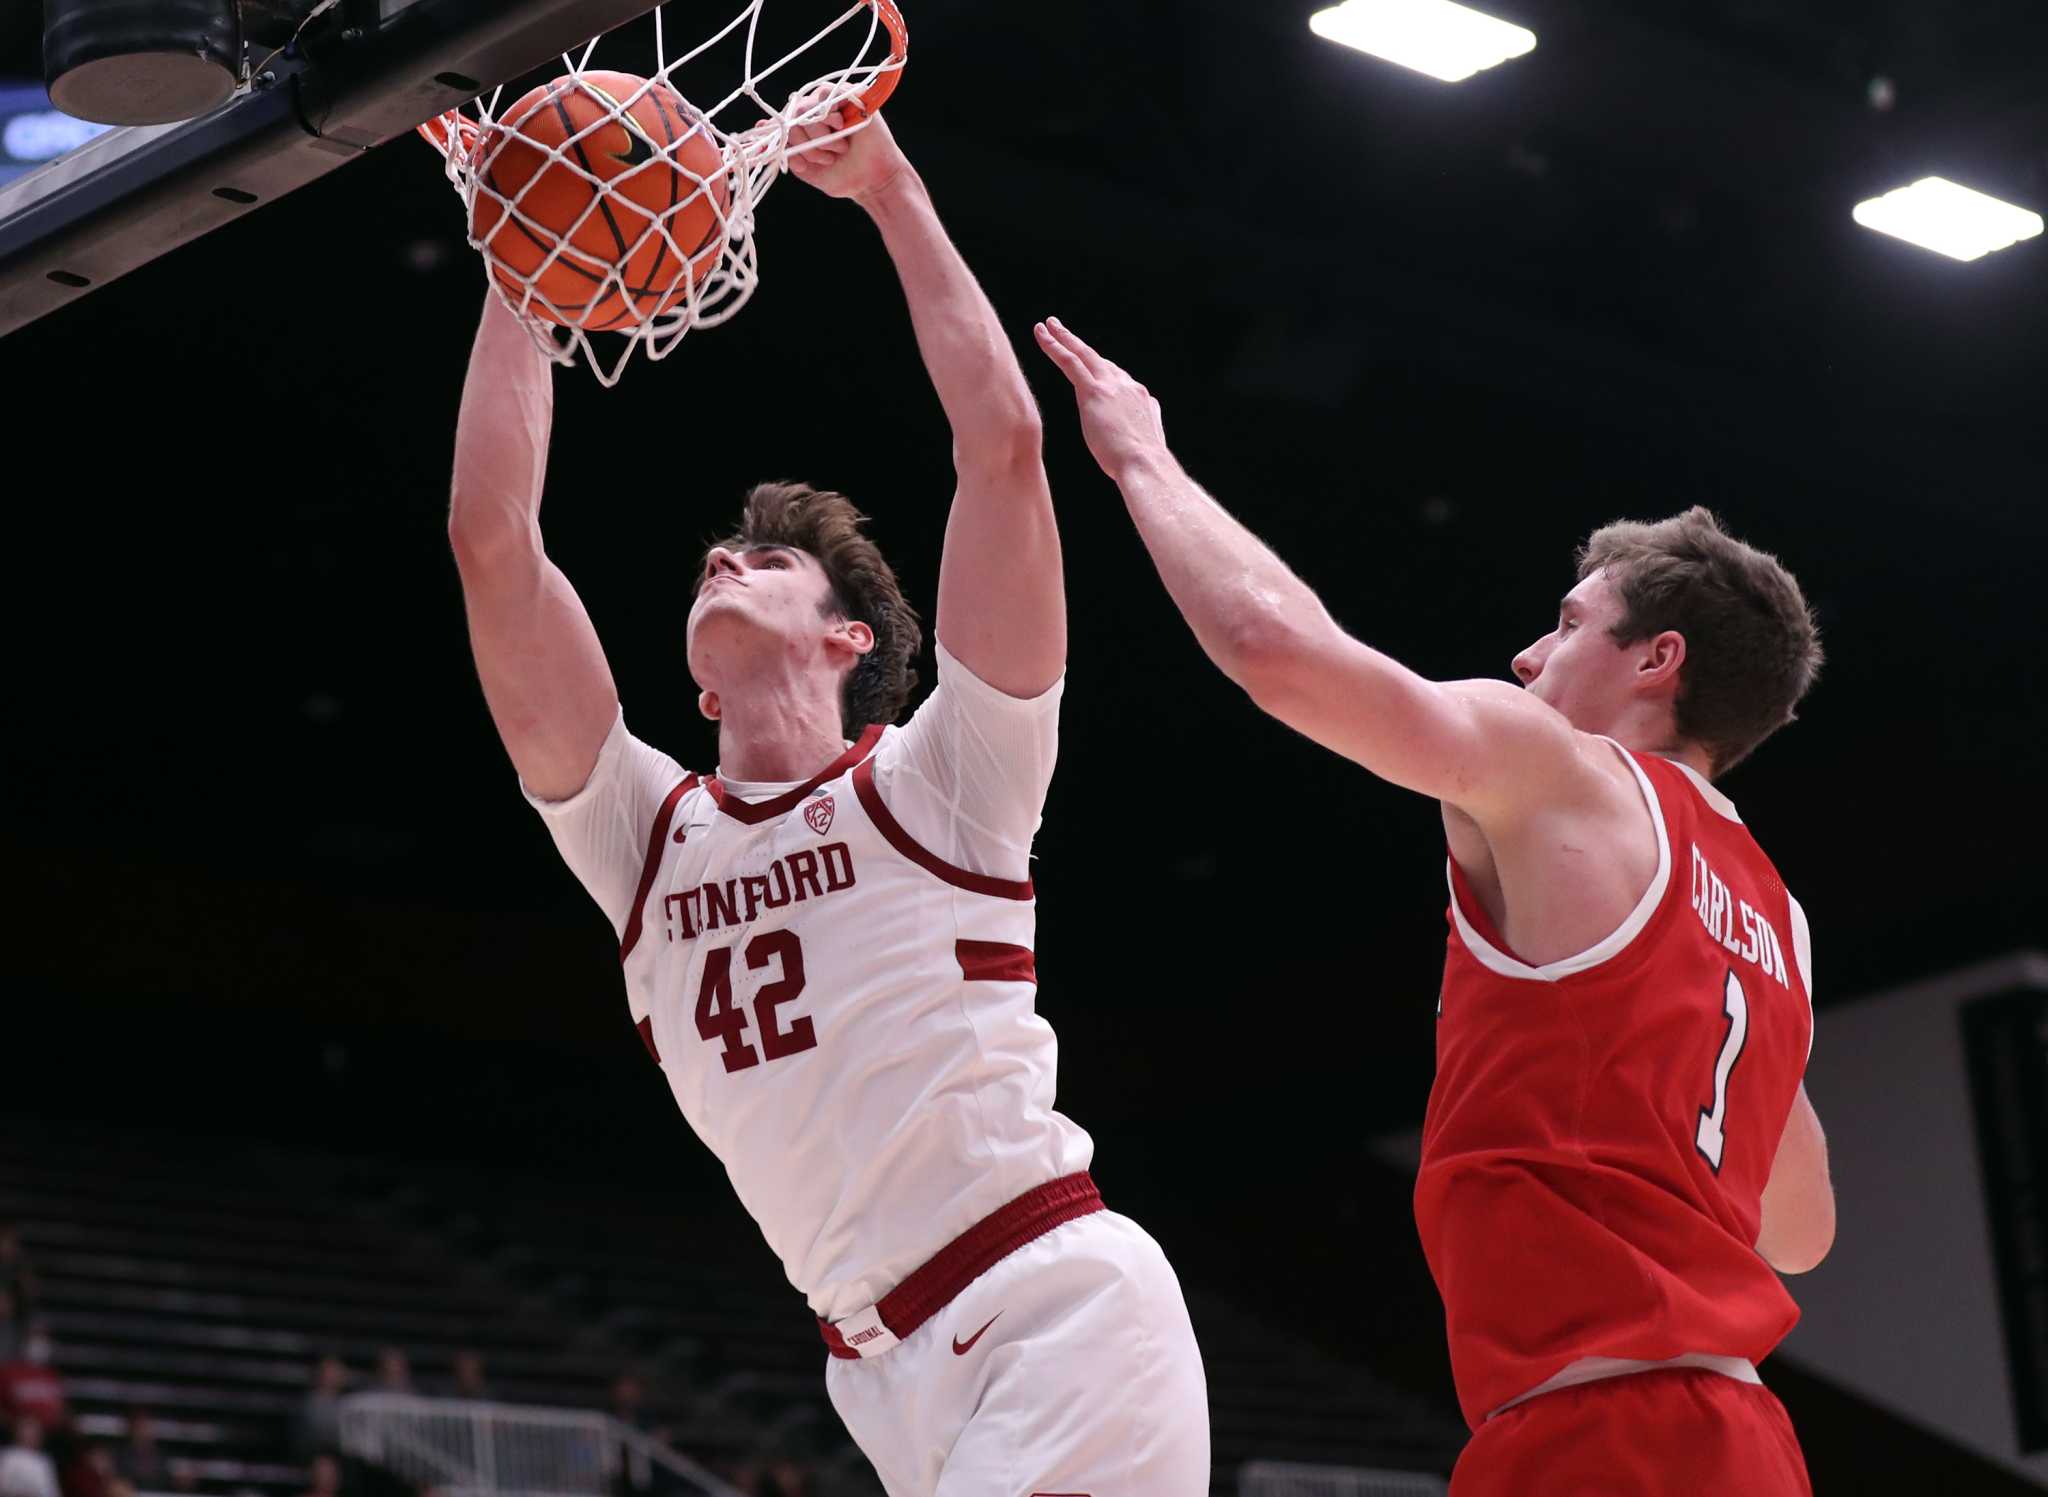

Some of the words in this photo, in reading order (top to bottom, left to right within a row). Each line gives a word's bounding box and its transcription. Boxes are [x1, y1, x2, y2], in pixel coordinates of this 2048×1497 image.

[664, 841, 857, 943] TNFORD
[813, 812, 828, 828] 12
[1691, 841, 1790, 991] CARLSON
[694, 928, 818, 1074] 42
[1696, 966, 1749, 1176] 1
